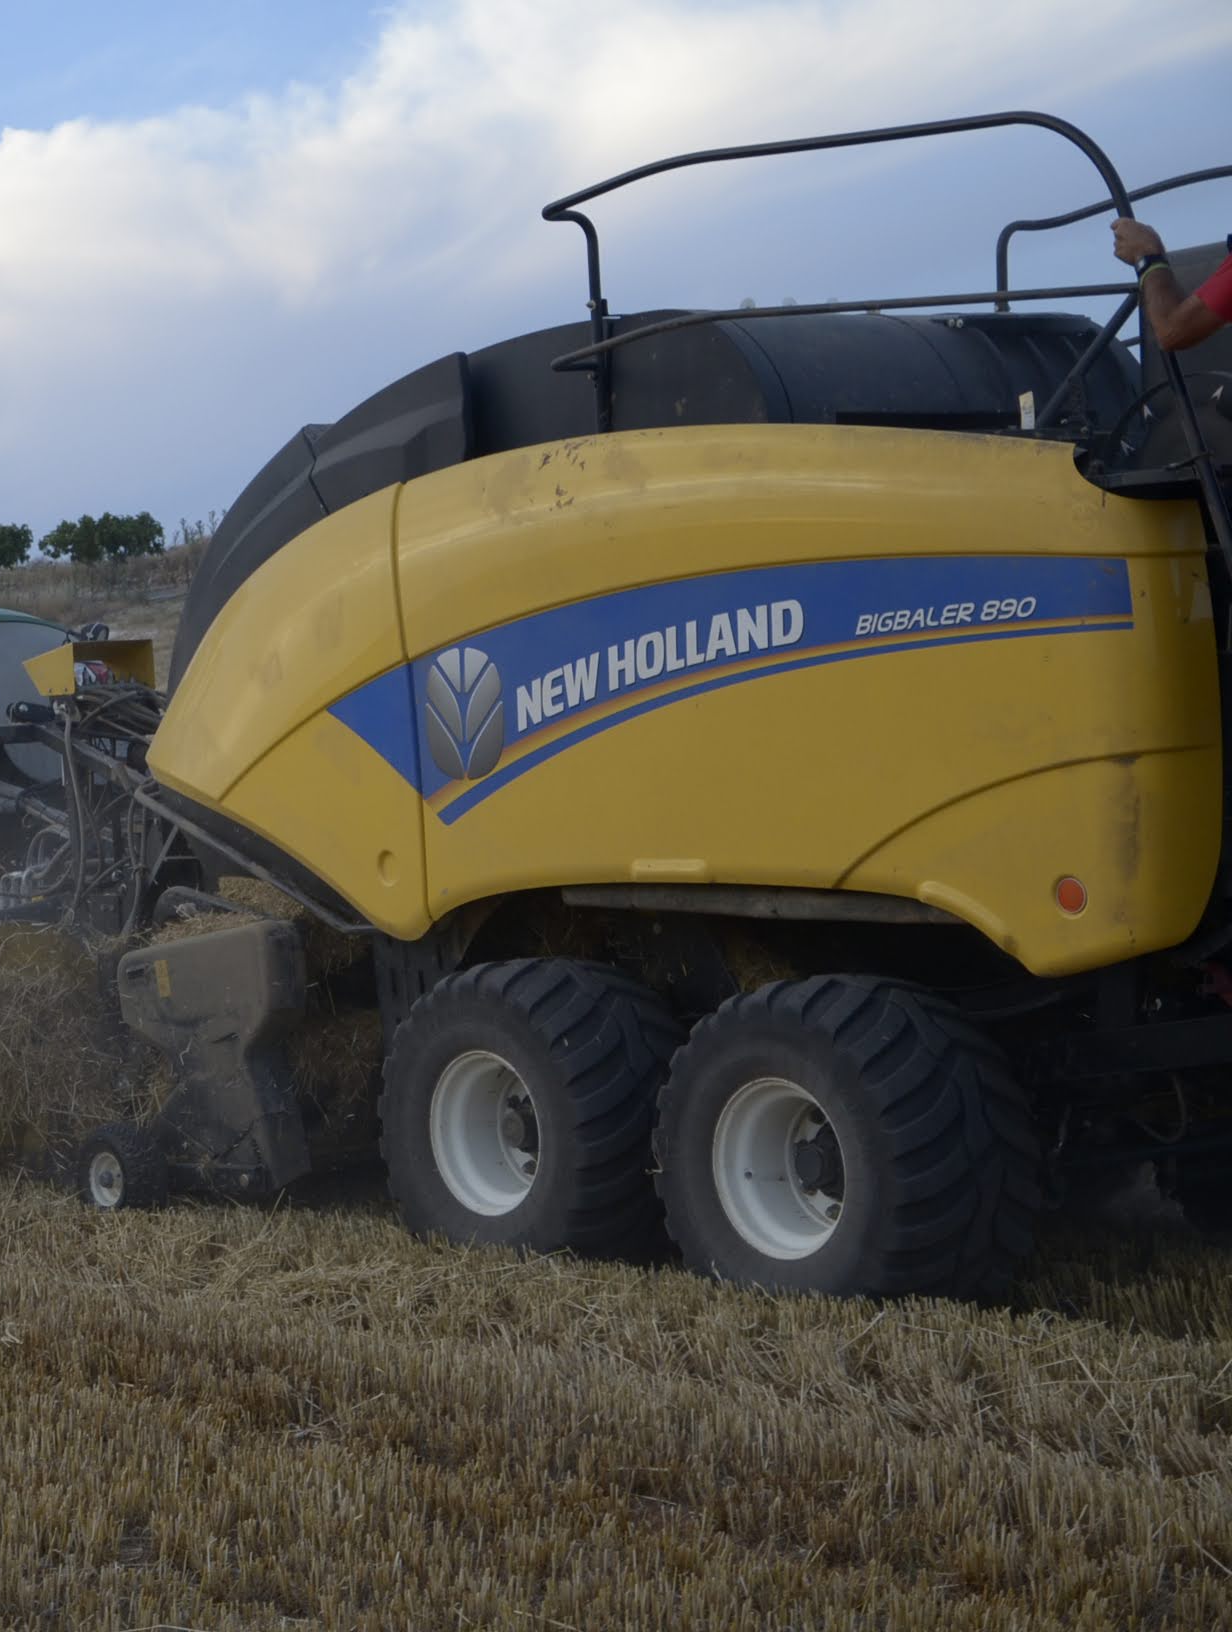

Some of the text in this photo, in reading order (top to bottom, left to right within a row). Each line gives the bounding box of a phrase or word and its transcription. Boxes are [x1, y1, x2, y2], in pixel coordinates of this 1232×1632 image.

[855, 597, 1037, 636] BIGBALER 890
[516, 599, 804, 732] NEW HOLLAND
